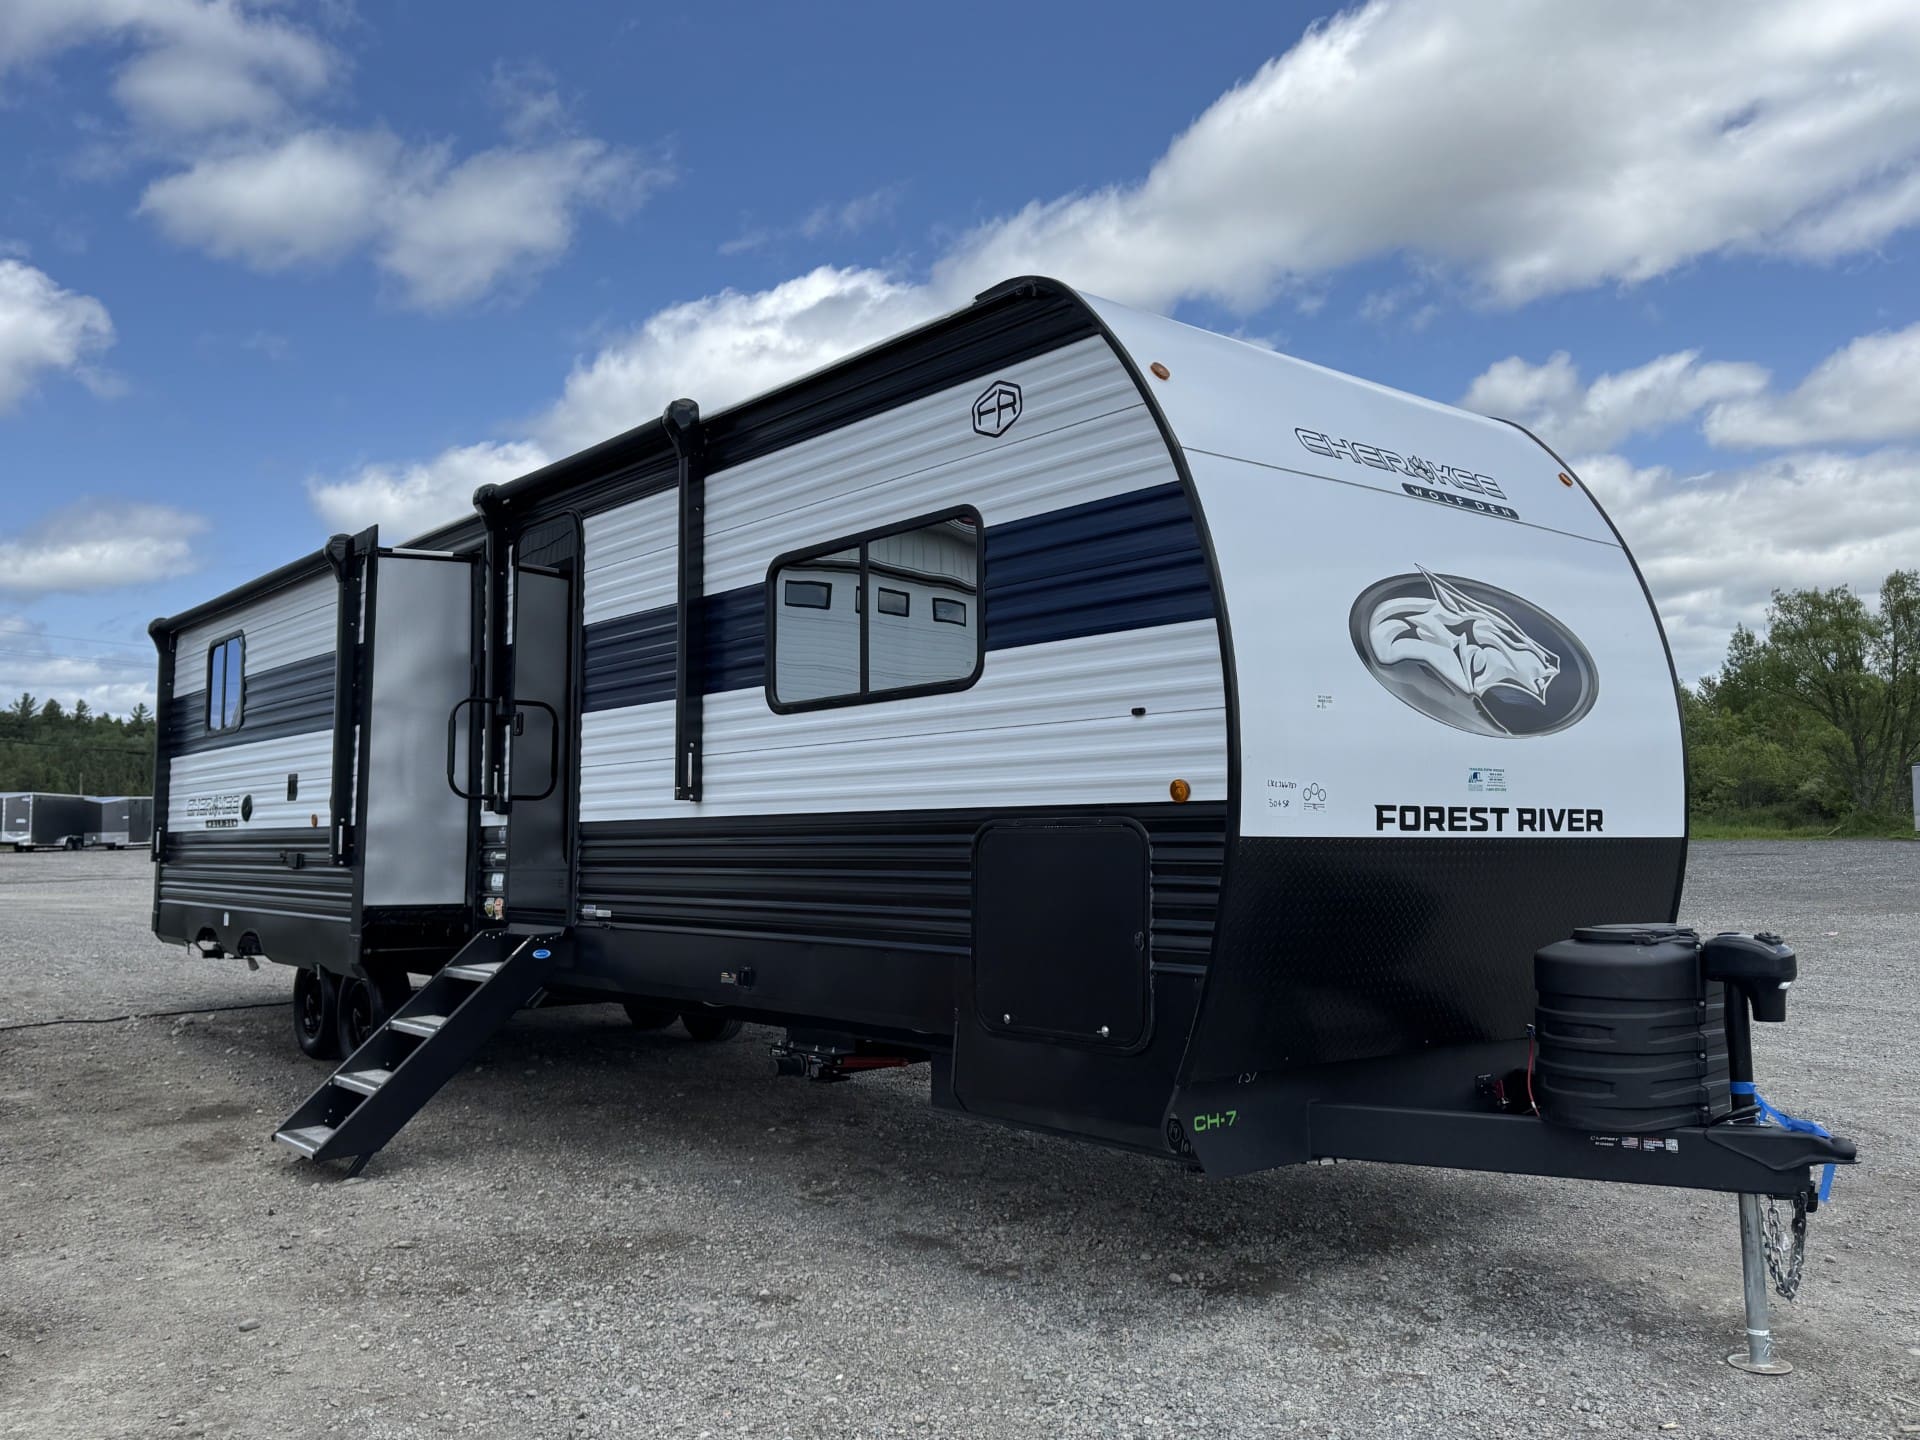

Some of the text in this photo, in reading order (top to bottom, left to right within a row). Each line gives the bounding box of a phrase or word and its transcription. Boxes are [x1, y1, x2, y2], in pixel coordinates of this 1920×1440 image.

[1412, 486, 1511, 517] WOLF DEN
[1374, 804, 1603, 832] FOREST RIVER
